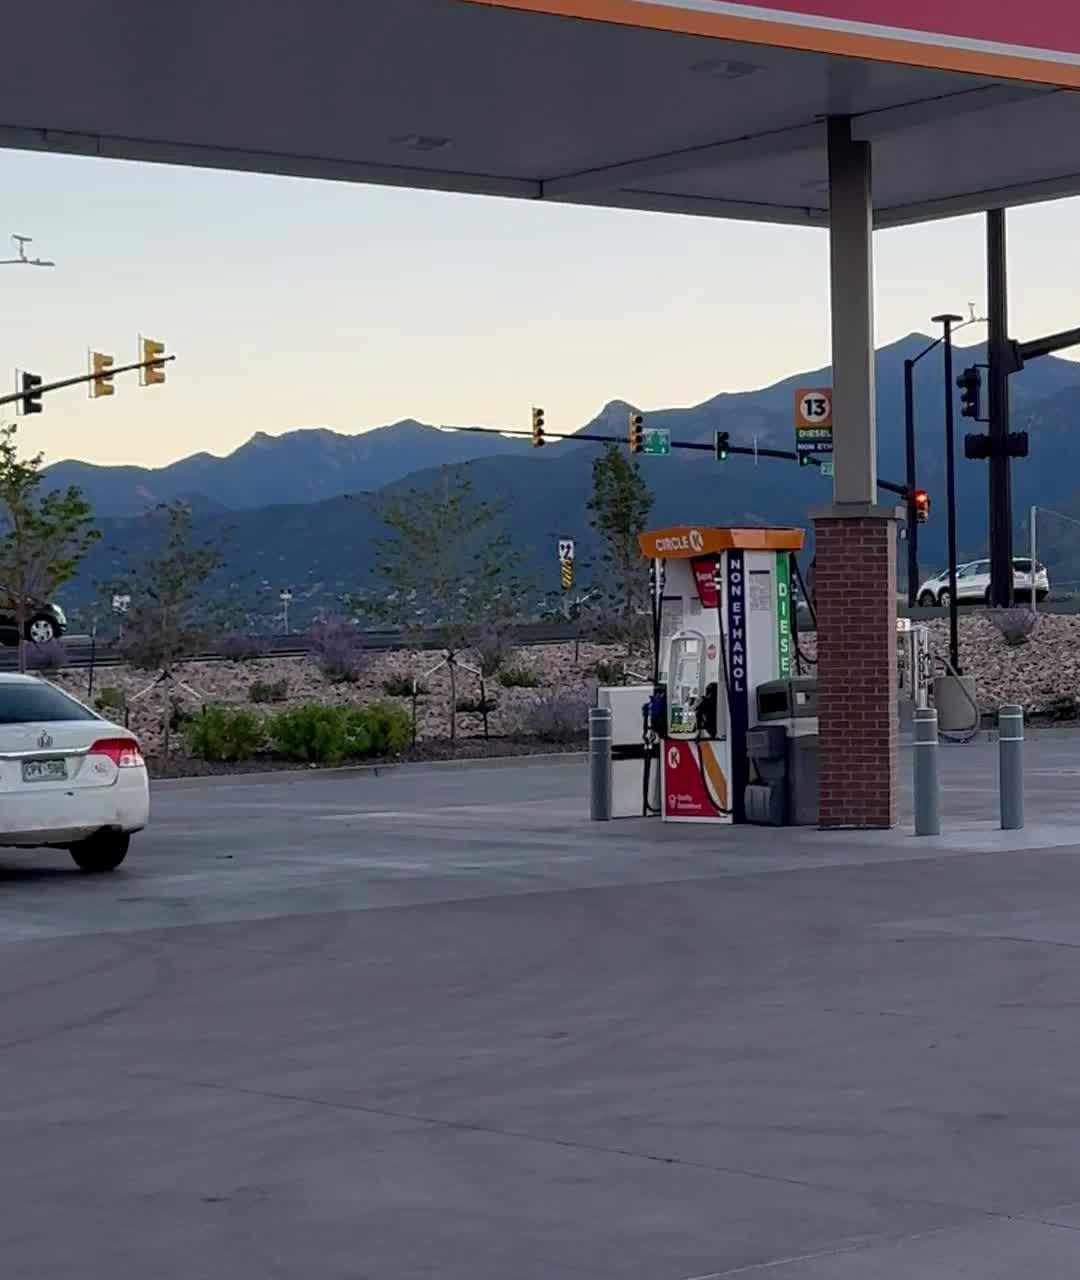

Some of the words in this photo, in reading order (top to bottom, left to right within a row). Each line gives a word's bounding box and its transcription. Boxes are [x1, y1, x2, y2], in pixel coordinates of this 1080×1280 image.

[804, 399, 827, 417] 13
[799, 429, 832, 438] DIESEL
[655, 535, 689, 551] CIRCLE
[690, 531, 704, 550] K
[731, 559, 742, 596] NON
[778, 582, 789, 674] DIESE
[732, 602, 744, 692] ETHANOL
